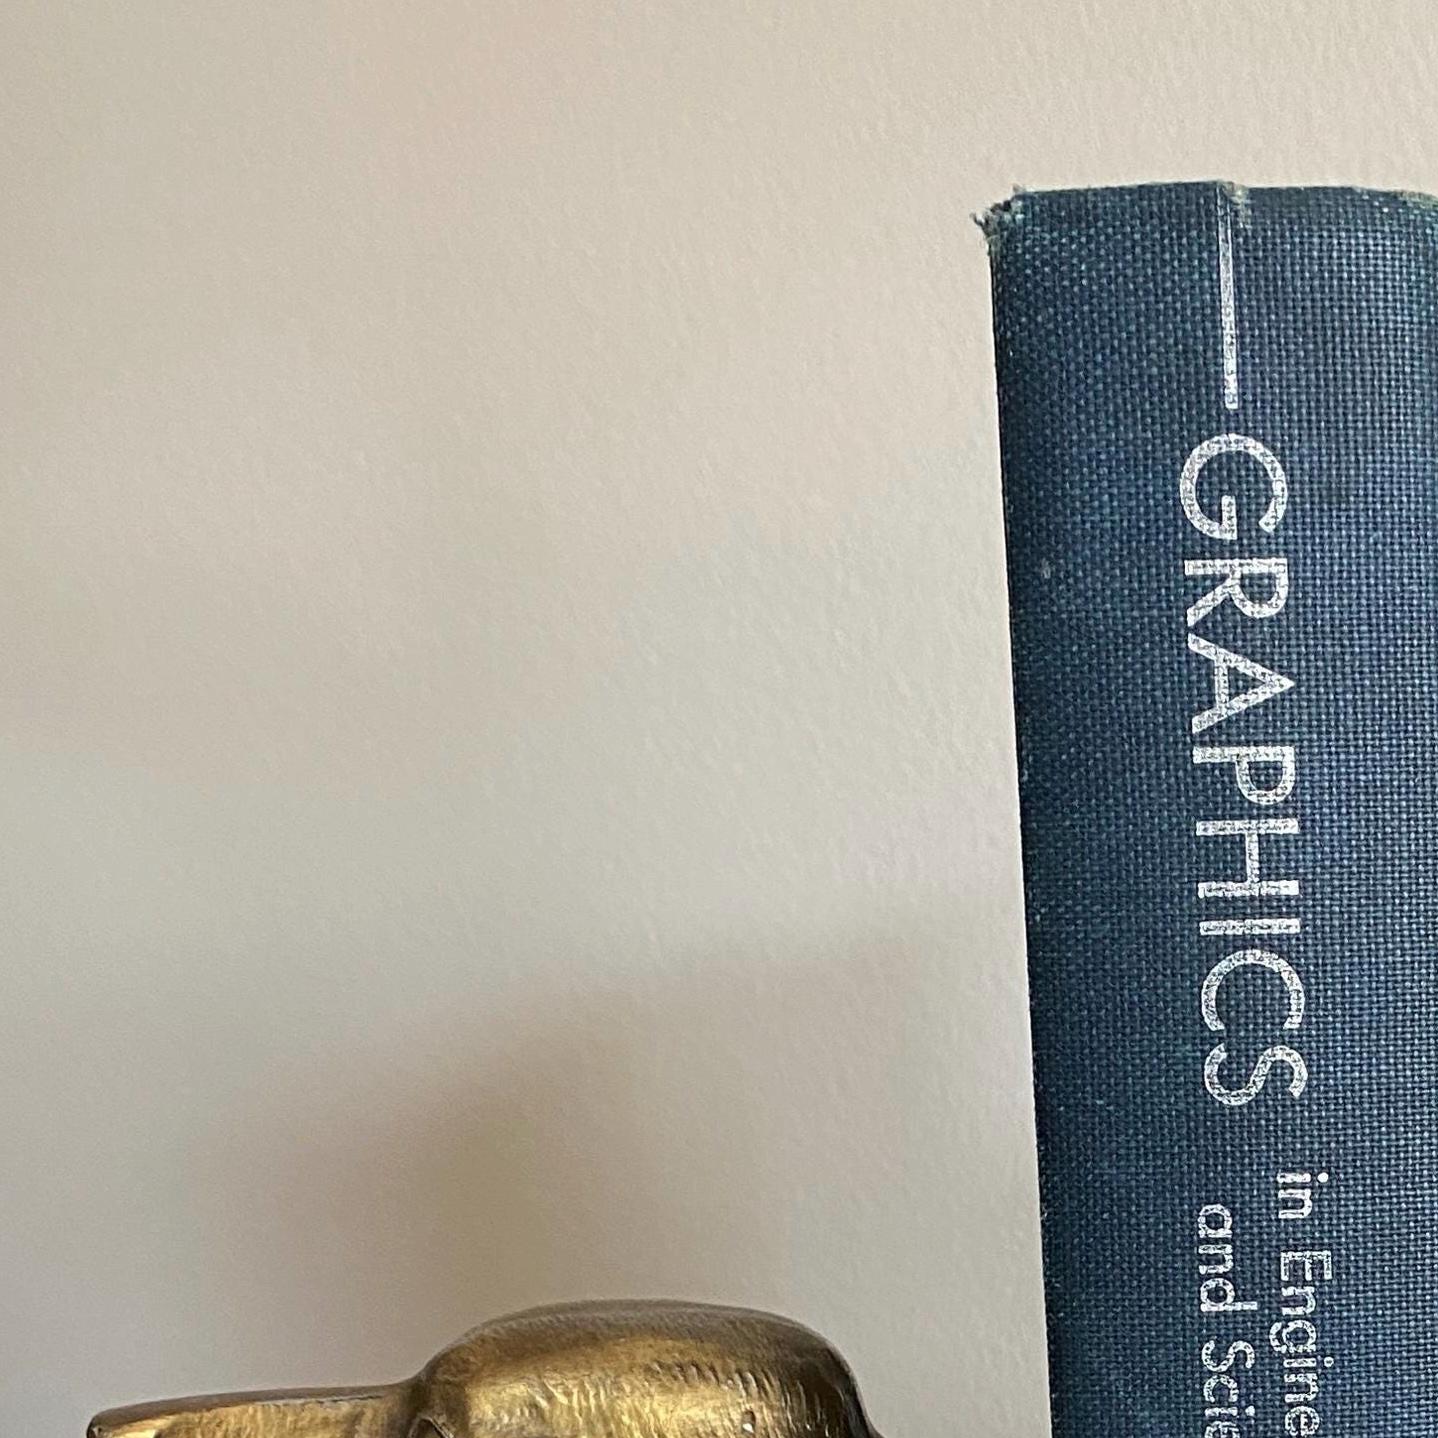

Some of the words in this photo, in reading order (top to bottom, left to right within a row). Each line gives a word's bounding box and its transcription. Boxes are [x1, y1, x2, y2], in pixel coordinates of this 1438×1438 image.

[1178, 433, 1309, 1106] GRAPHICS
[1277, 1170, 1330, 1220] in
[1197, 1203, 1258, 1313] and
